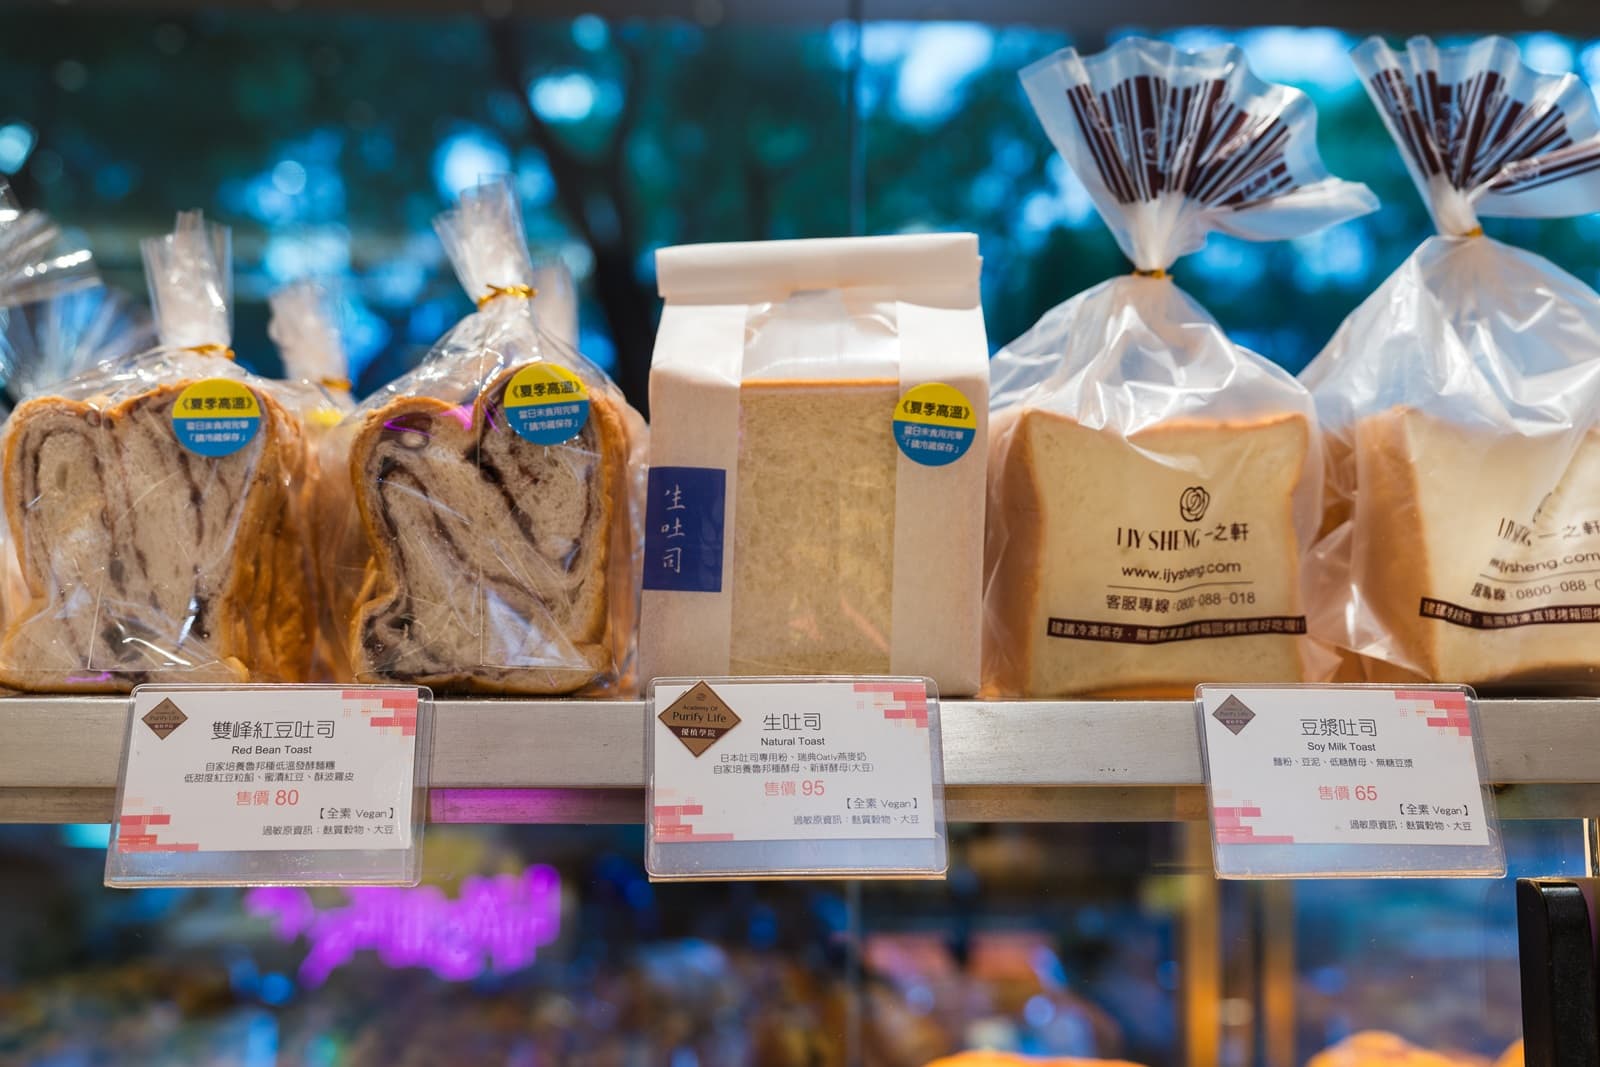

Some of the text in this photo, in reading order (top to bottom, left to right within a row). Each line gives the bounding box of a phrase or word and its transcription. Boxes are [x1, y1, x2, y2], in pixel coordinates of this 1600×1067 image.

[660, 483, 686, 574] 生吐司
[1121, 562, 1242, 584] www.ijysheng.com
[672, 711, 727, 723] Purify Life
[762, 712, 821, 731] 生吐司
[211, 720, 335, 740] 雙峰紅豆吐司
[1300, 718, 1377, 737] 豆漿吐司
[761, 736, 825, 746] Natural Toast
[1307, 742, 1376, 752] Soy Milk Toast
[232, 745, 312, 755] Red Bean Toast
[764, 780, 825, 797] 售價 95
[1318, 785, 1378, 801] 售價 65
[236, 789, 299, 806] 售價 80
